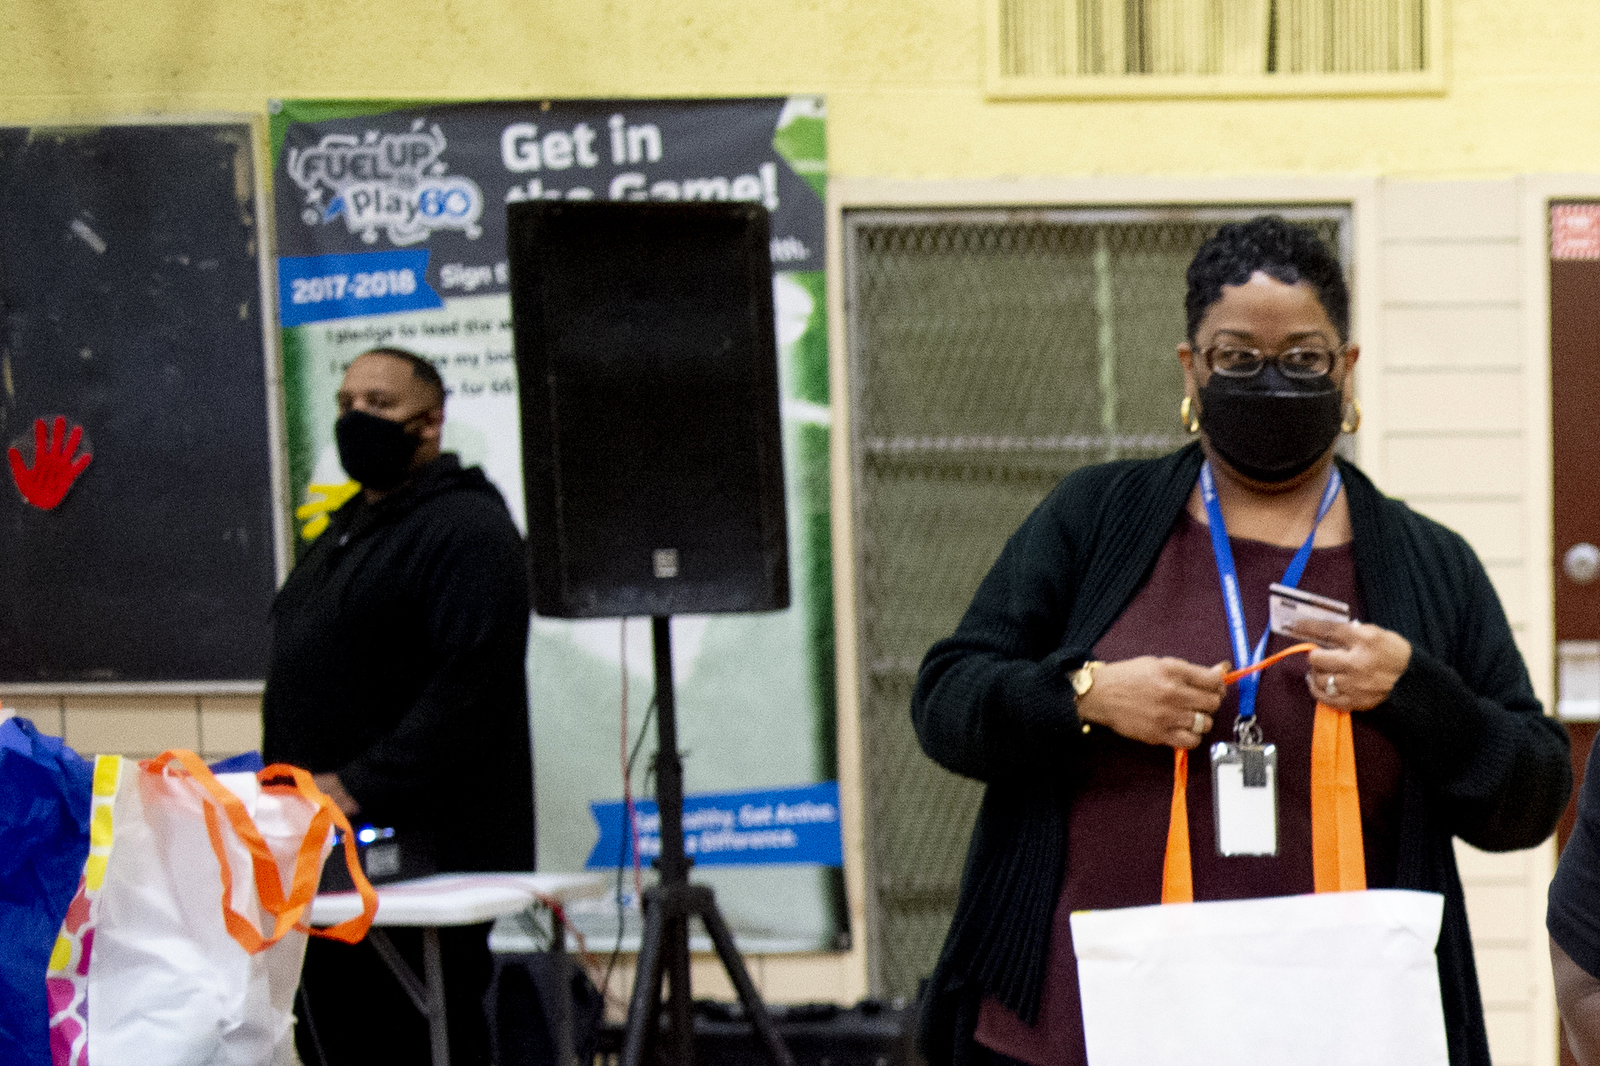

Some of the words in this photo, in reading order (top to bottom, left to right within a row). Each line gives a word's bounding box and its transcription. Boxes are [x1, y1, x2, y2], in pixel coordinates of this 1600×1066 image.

[385, 139, 432, 169] UP
[501, 119, 598, 172] Get
[607, 112, 663, 165] in
[608, 162, 779, 211] Game!
[291, 268, 417, 304] 2017-2018
[440, 263, 493, 291] Sign
